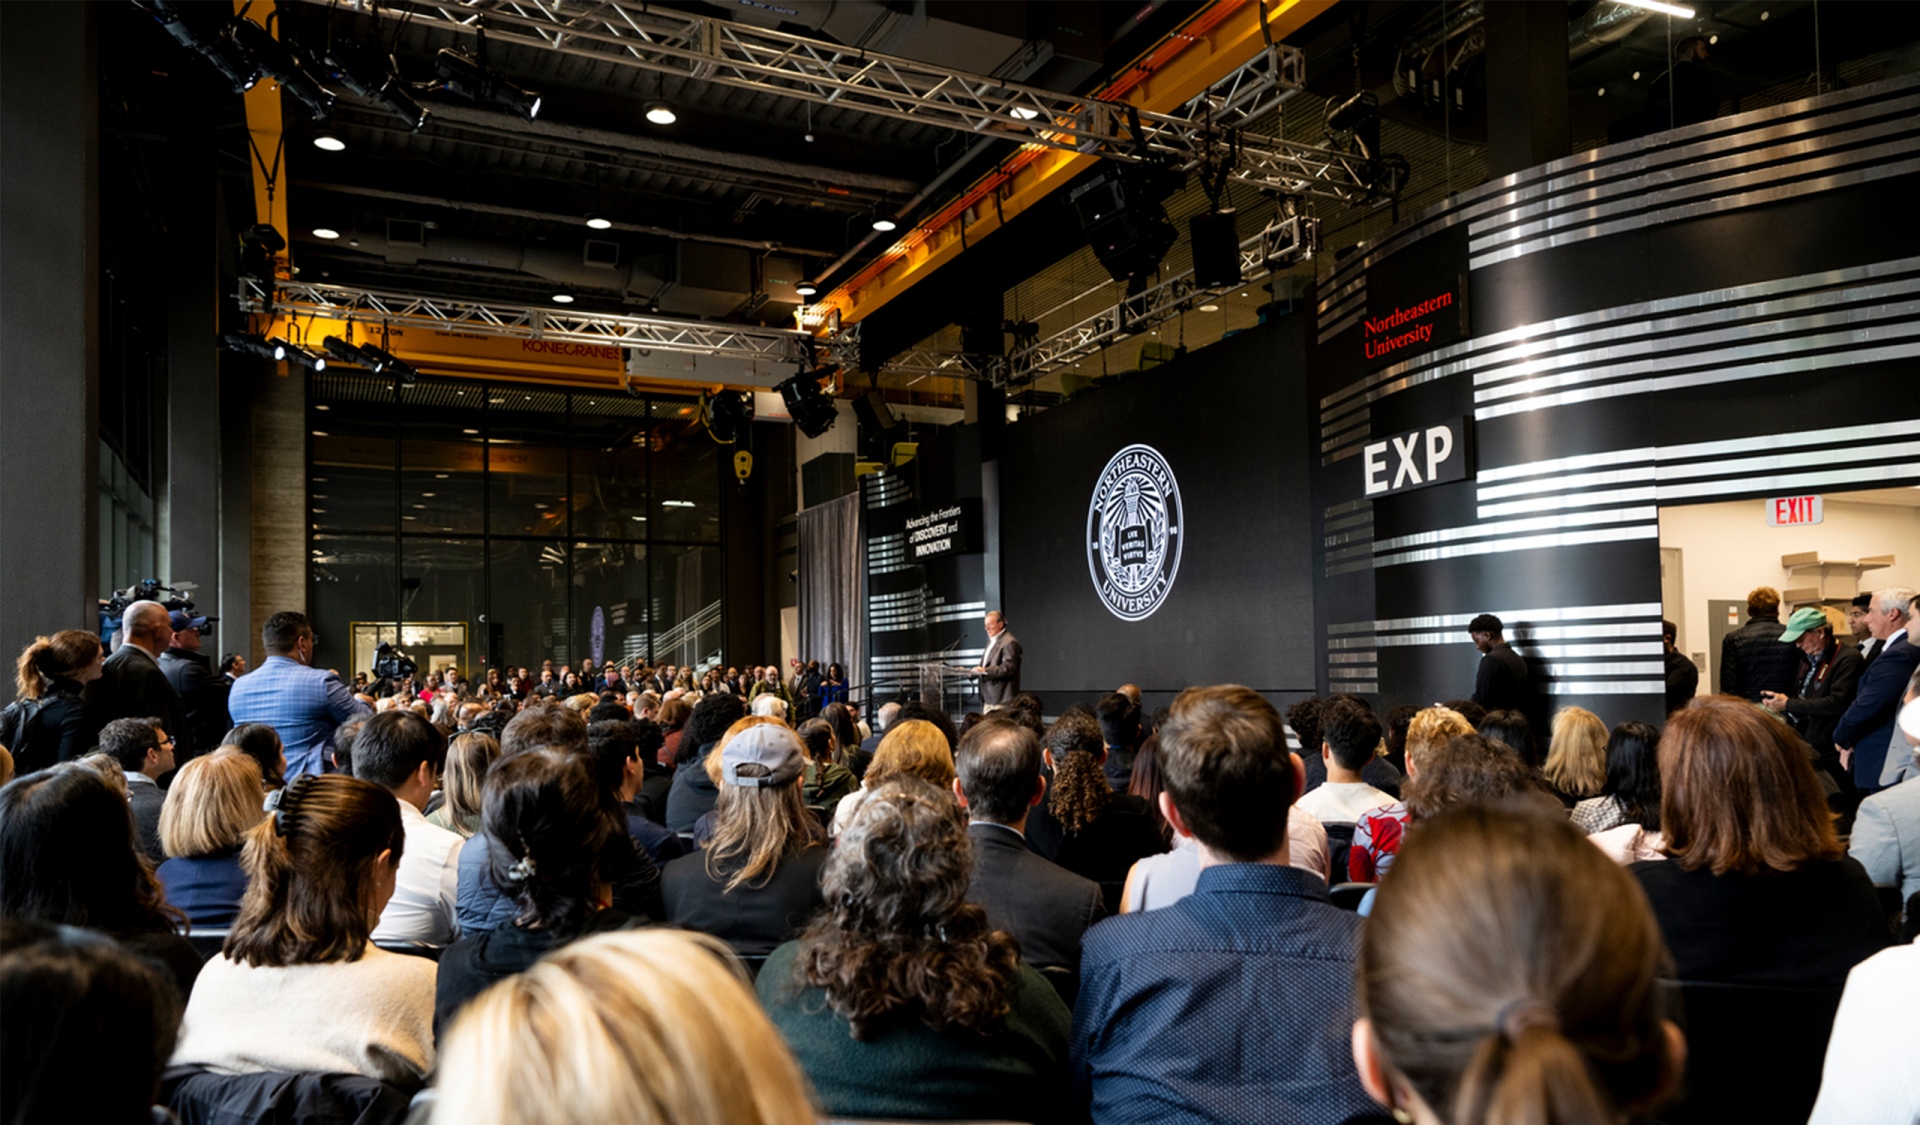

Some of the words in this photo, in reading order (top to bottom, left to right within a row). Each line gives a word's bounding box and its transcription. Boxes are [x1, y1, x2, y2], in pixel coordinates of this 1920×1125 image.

[369, 326, 381, 334] 12
[1364, 292, 1452, 338] Northeastern
[1365, 323, 1433, 359] University
[1364, 425, 1453, 496] EXP
[1095, 453, 1172, 513] NORTHEASTERN
[906, 515, 930, 529] Advancing
[930, 512, 938, 522] the
[939, 506, 961, 519] Frontiers
[1775, 495, 1815, 525] EXIT
[915, 523, 948, 541] DISCOVERY
[948, 520, 958, 533] and
[1121, 540, 1145, 551] VERITAS
[916, 538, 951, 557] INNOVATION
[1103, 570, 1167, 612] UNIVERSITY
